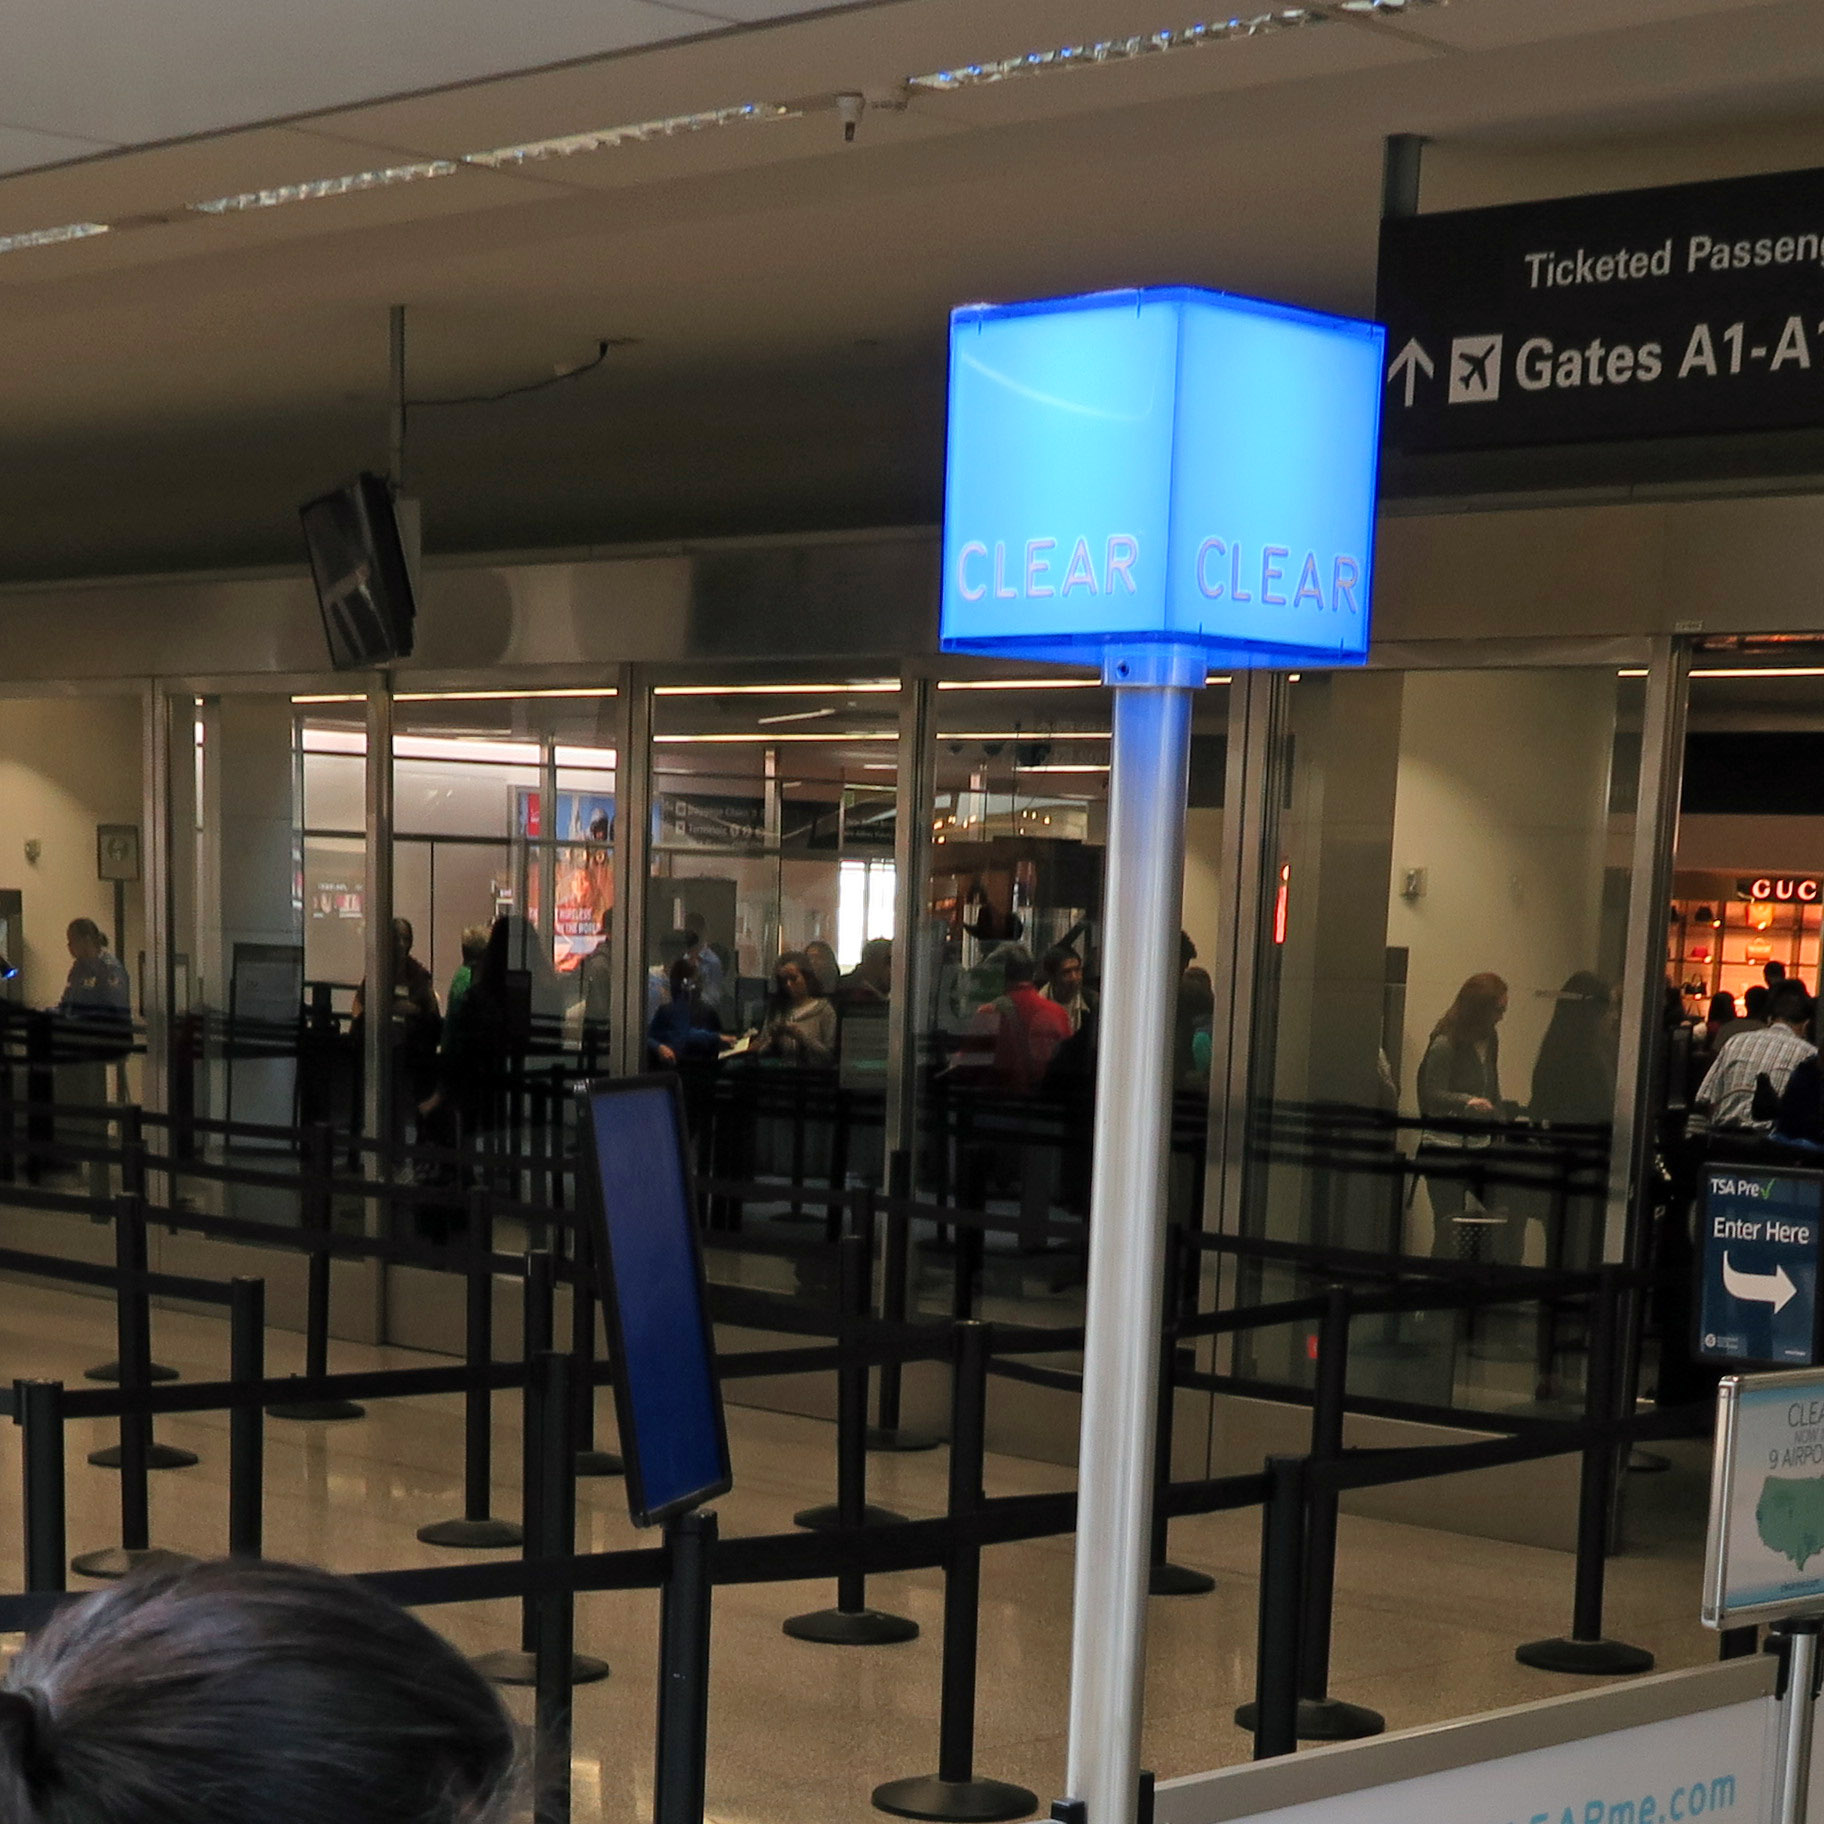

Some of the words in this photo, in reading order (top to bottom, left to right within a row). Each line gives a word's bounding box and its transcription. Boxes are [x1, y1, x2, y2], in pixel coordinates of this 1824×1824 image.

[1525, 239, 1673, 288] Ticketed
[1515, 336, 1663, 391] Gates
[956, 533, 1140, 601] CLEAR
[1196, 536, 1360, 614] CLEAR
[1710, 1178, 1736, 1196] TSA
[1737, 1180, 1760, 1197] Pre
[1713, 1216, 1762, 1241] Enter
[1765, 1220, 1810, 1244] Here
[1794, 1429, 1822, 1444] NOW
[1769, 1448, 1779, 1470] 9
